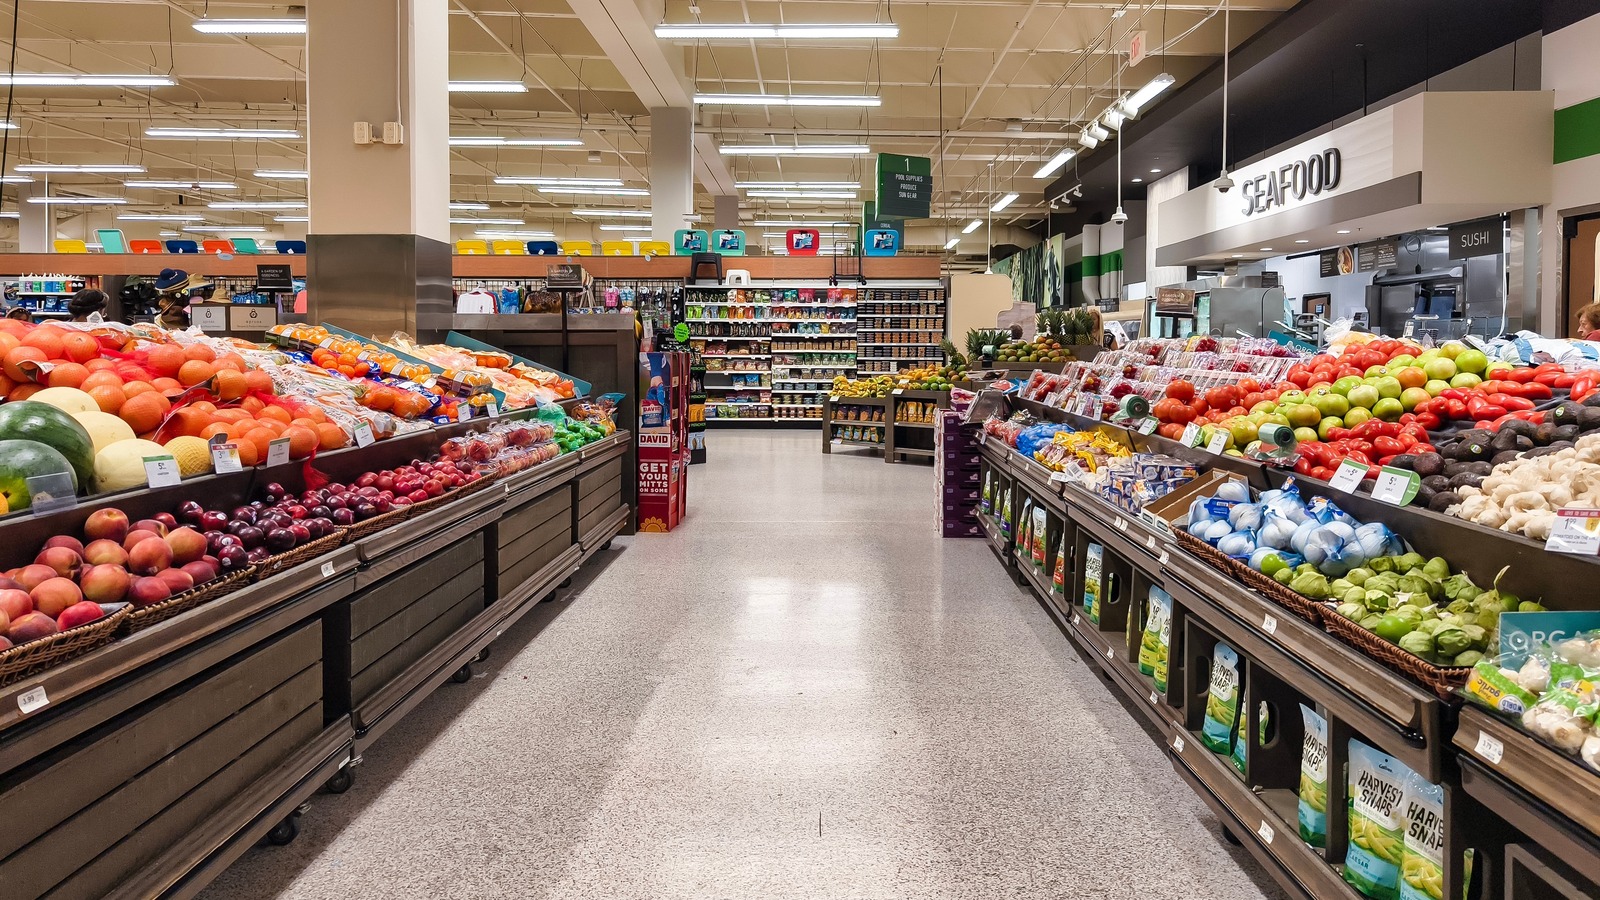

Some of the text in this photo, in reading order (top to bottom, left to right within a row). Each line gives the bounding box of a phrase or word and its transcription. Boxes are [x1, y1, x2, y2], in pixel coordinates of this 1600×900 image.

[904, 158, 909, 171] 1
[1242, 147, 1341, 217] SEAFOOD
[1461, 230, 1489, 248] SUSHI
[640, 435, 668, 444] DAVID
[640, 462, 668, 473] GET
[1477, 678, 1501, 698] garlic
[1502, 699, 1523, 713] WORLD
[1358, 770, 1404, 807] HARVEST
[1360, 788, 1393, 818] SNAPS
